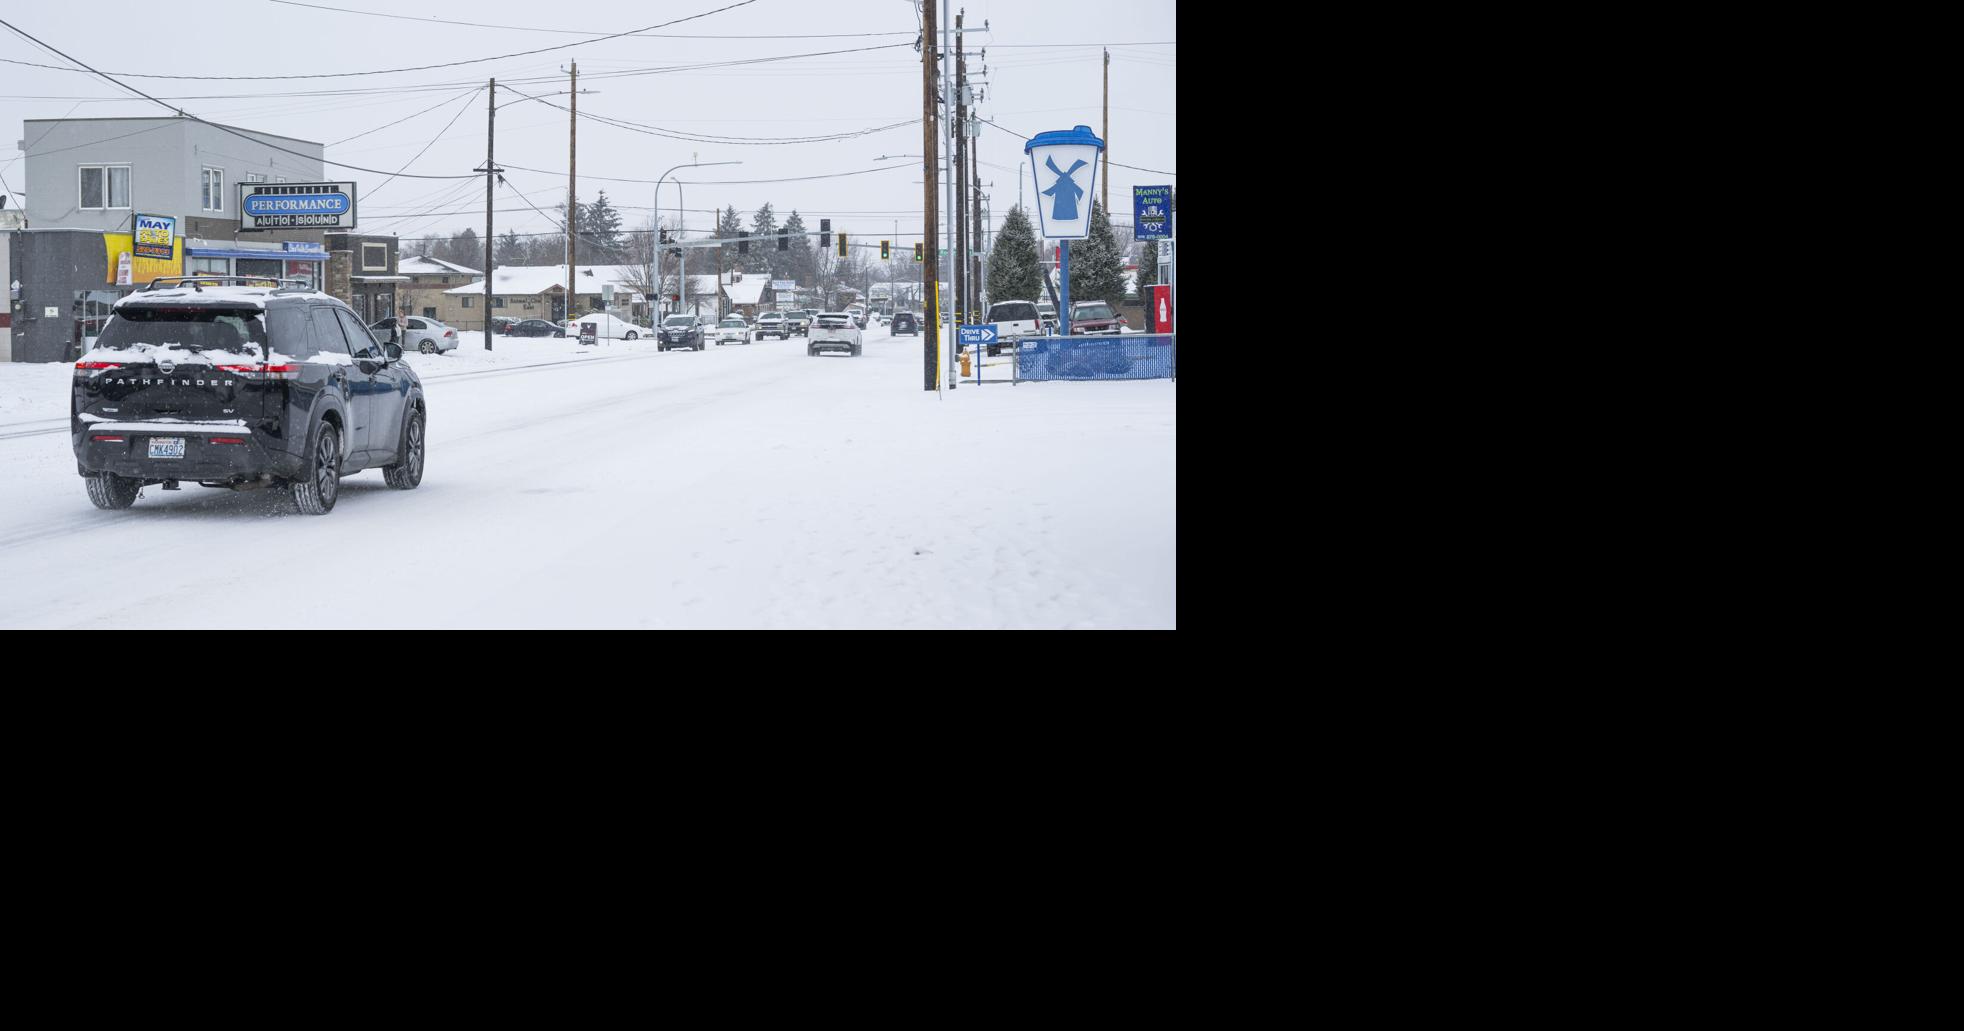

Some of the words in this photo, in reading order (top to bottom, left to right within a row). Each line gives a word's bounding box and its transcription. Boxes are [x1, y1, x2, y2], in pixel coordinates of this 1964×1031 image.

[1136, 188, 1168, 197] MANNY'S
[251, 199, 341, 210] PERFORMANCE
[140, 220, 170, 230] MAY
[105, 378, 233, 386] PATHFINDER
